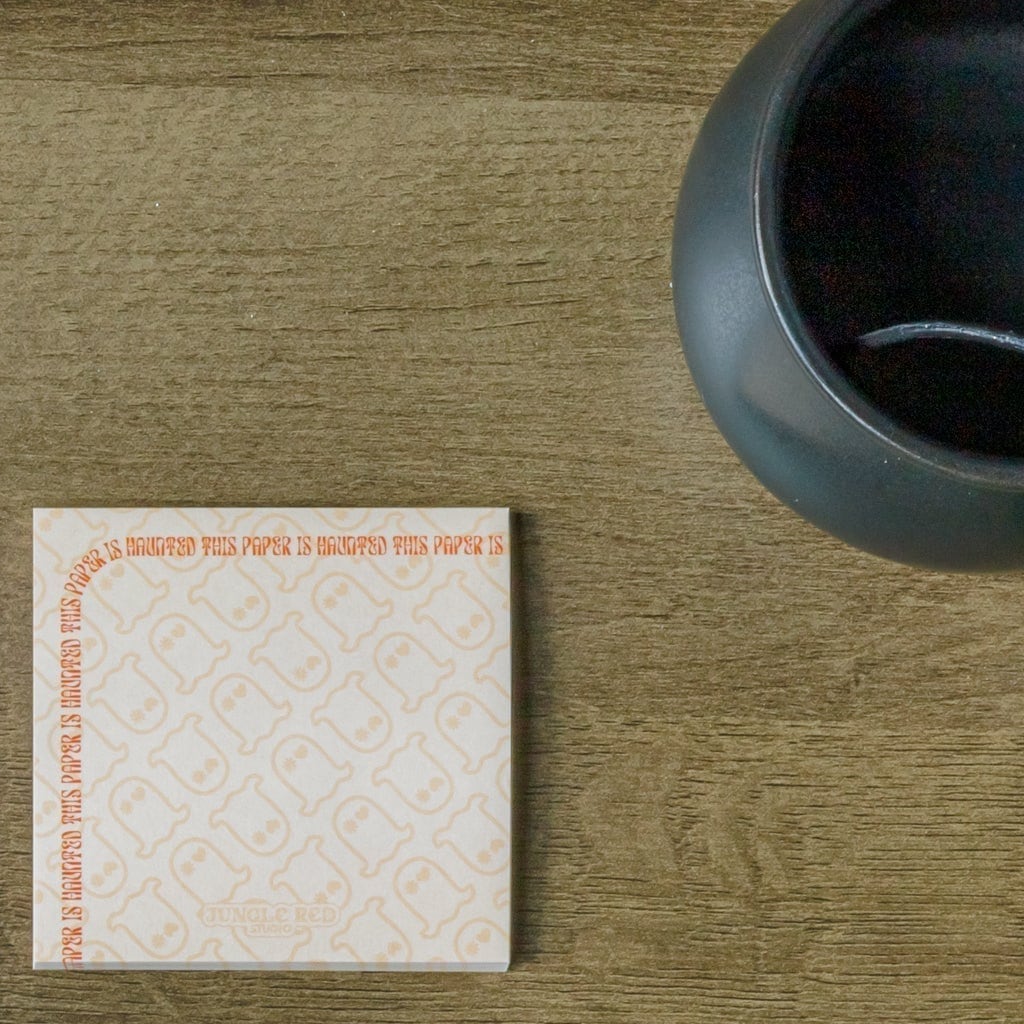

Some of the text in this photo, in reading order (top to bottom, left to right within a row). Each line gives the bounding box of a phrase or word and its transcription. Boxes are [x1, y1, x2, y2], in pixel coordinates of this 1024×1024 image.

[103, 539, 123, 561] IS
[125, 536, 197, 557] HAUNTED
[201, 535, 237, 556] THIS
[241, 535, 290, 556] PAPER
[297, 534, 312, 555] IS
[315, 535, 387, 556] HAUNTED
[393, 535, 428, 556] THIS
[433, 535, 483, 556] PAPER
[487, 534, 506, 556] IS
[63, 549, 107, 596] PAPER
[60, 598, 81, 633] THIS
[60, 640, 81, 707] HAUNTED
[60, 713, 81, 729] IS
[60, 733, 82, 784] PAPER
[60, 788, 82, 823] THIS
[60, 830, 82, 901] HAUNTED
[61, 906, 82, 920] IS
[206, 906, 336, 923] JUNGLE RED
